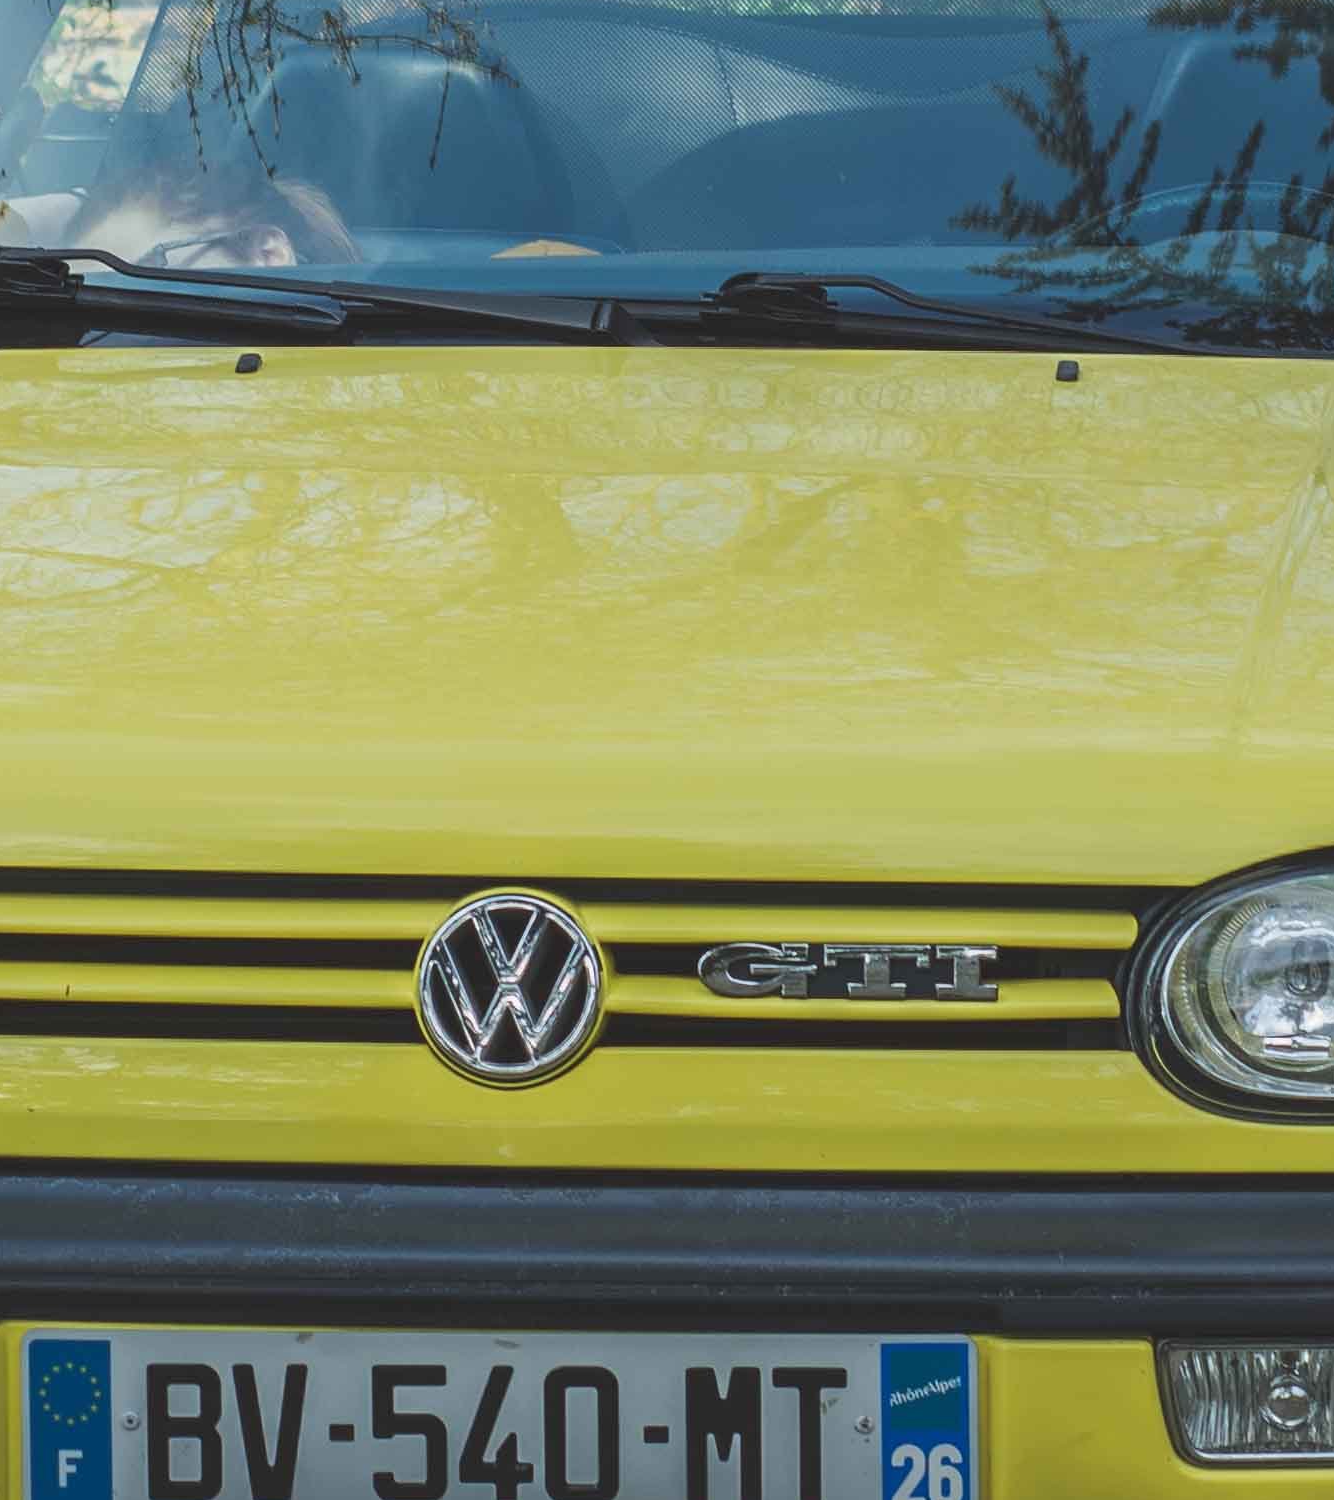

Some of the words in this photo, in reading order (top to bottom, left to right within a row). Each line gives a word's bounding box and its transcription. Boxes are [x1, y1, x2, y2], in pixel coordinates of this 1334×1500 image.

[420, 896, 598, 1071] VW
[698, 943, 999, 1002] GTI
[58, 1449, 84, 1488] F
